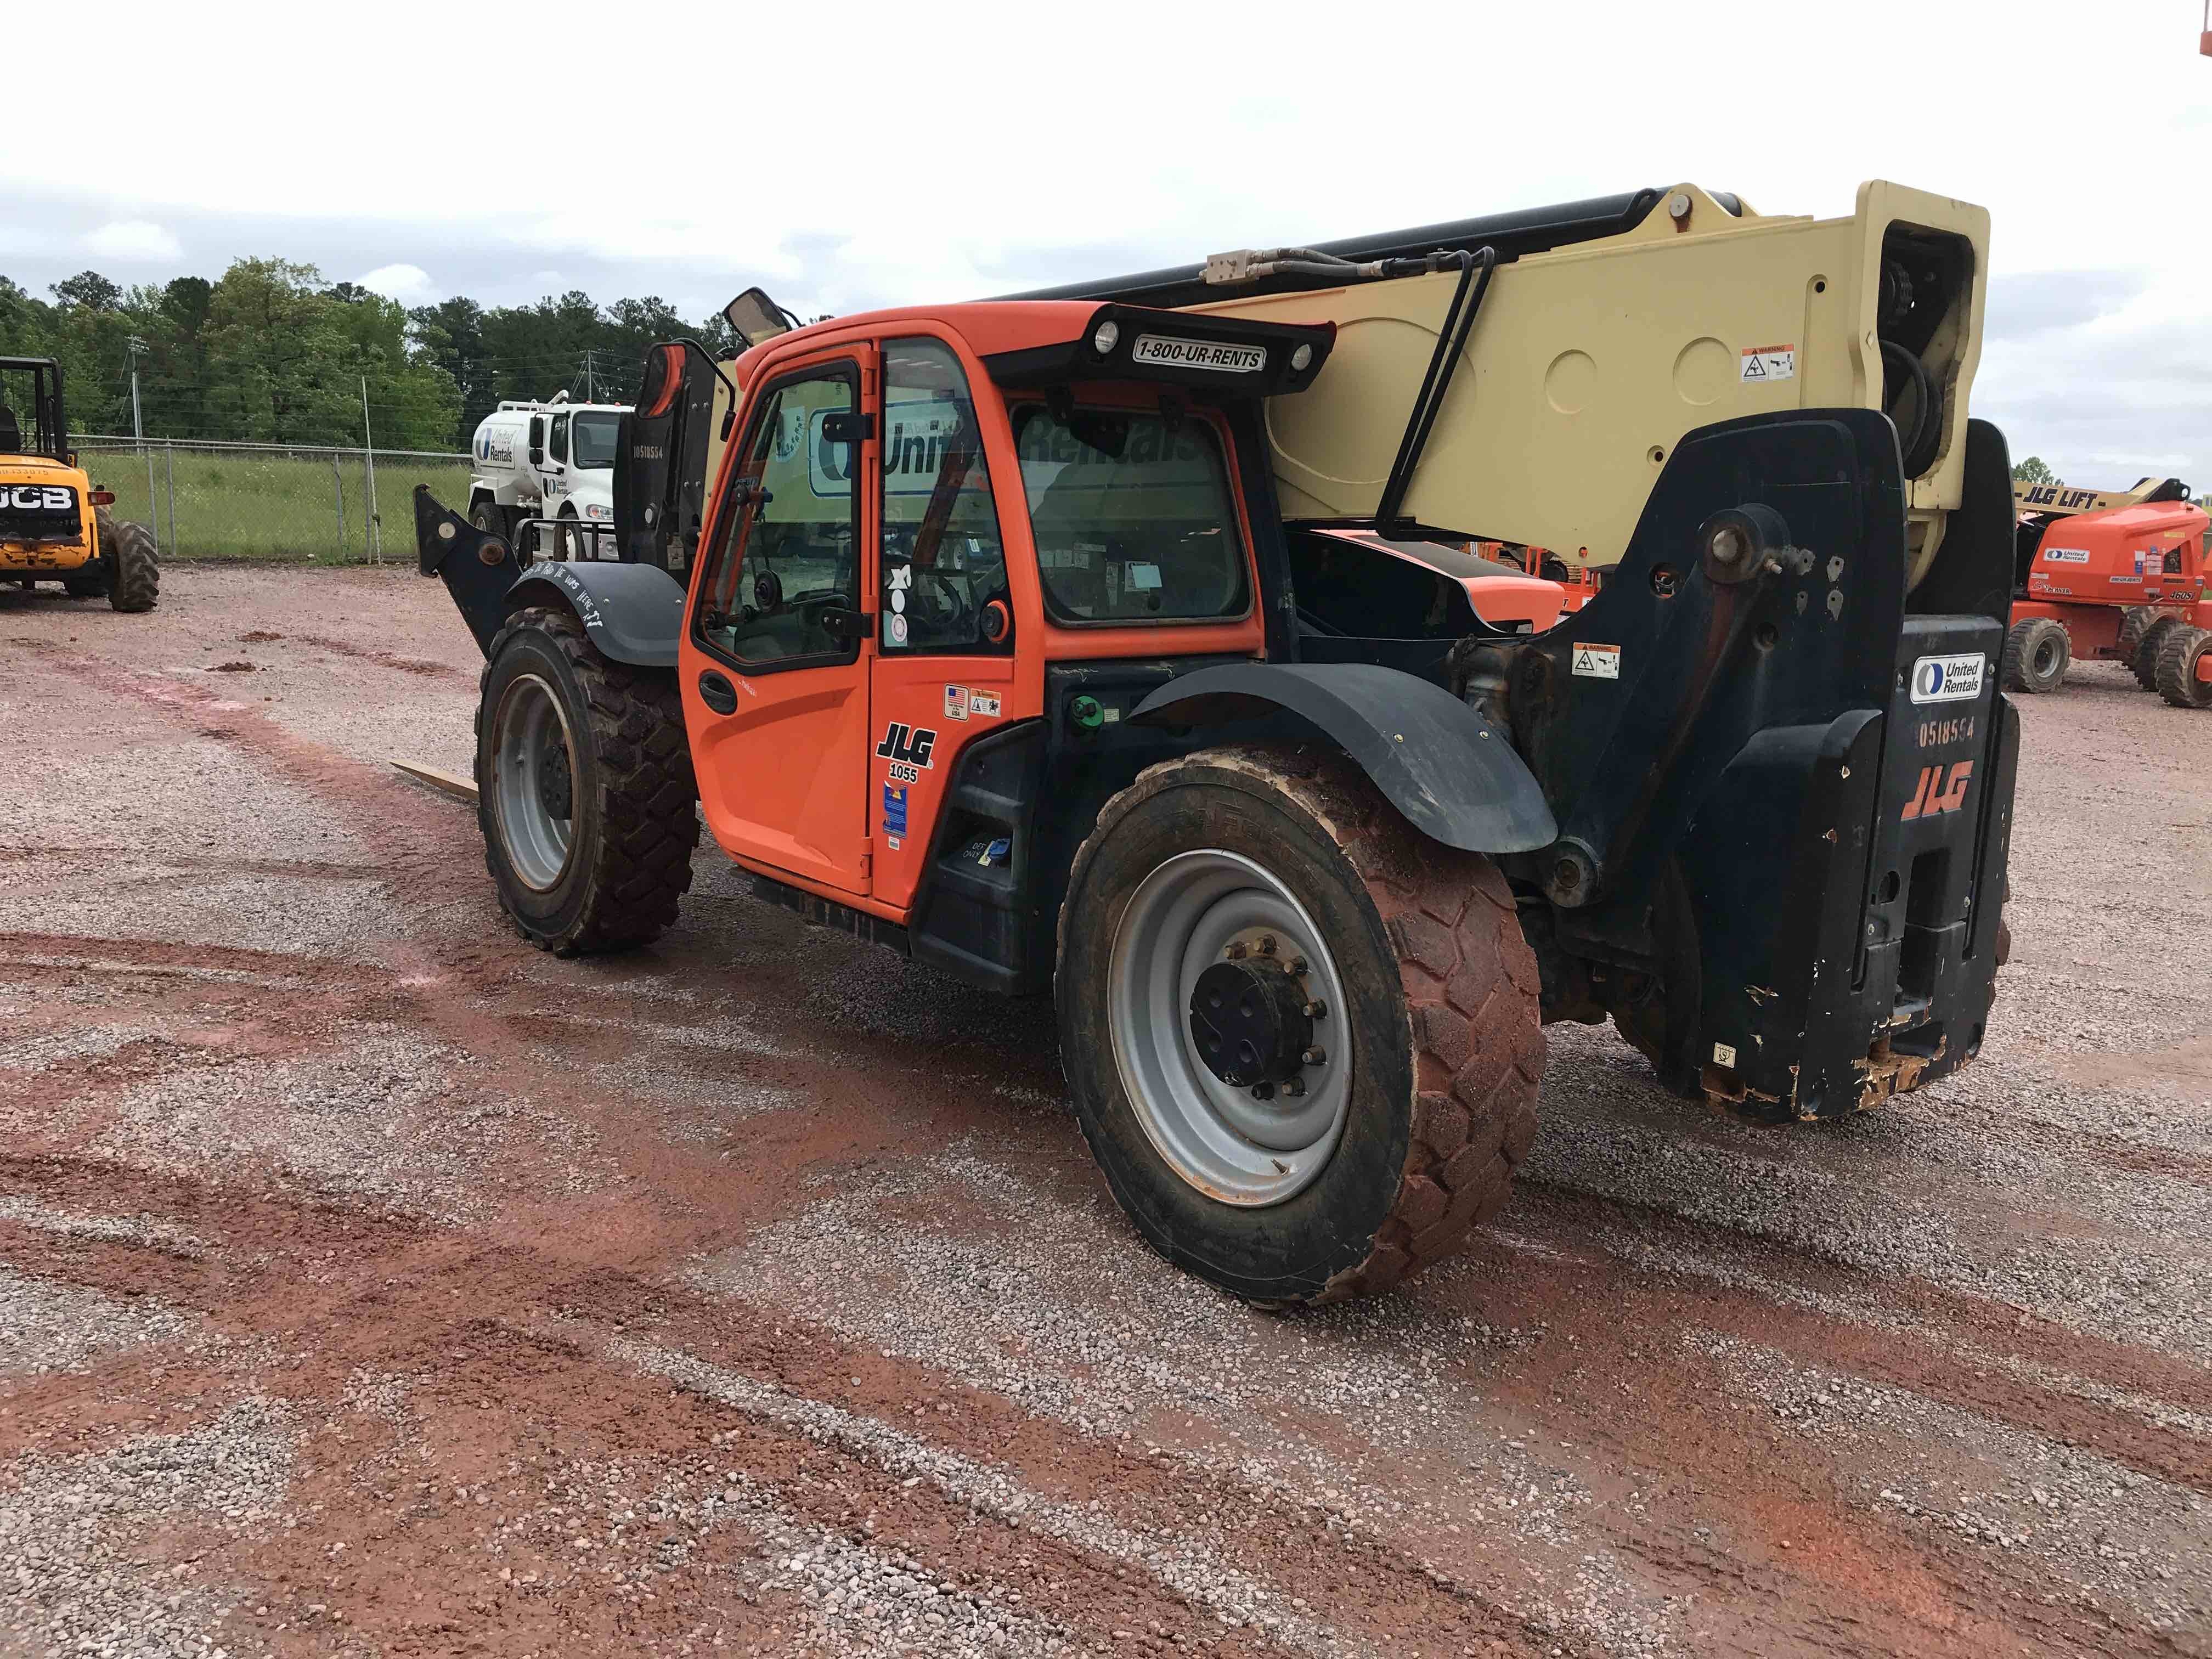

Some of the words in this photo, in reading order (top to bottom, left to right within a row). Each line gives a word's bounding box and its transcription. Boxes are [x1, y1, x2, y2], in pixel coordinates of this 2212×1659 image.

[1139, 341, 1260, 368] 1-800-UR-RENTS
[490, 445, 512, 462] Rentals
[2023, 486, 2058, 505] JLG
[2058, 490, 2098, 510] LIFT
[1946, 661, 1979, 678] United
[1943, 677, 1979, 694] Rentals
[877, 723, 937, 767] JLG
[890, 763, 917, 783] 1055
[1901, 760, 1974, 821] JLG
